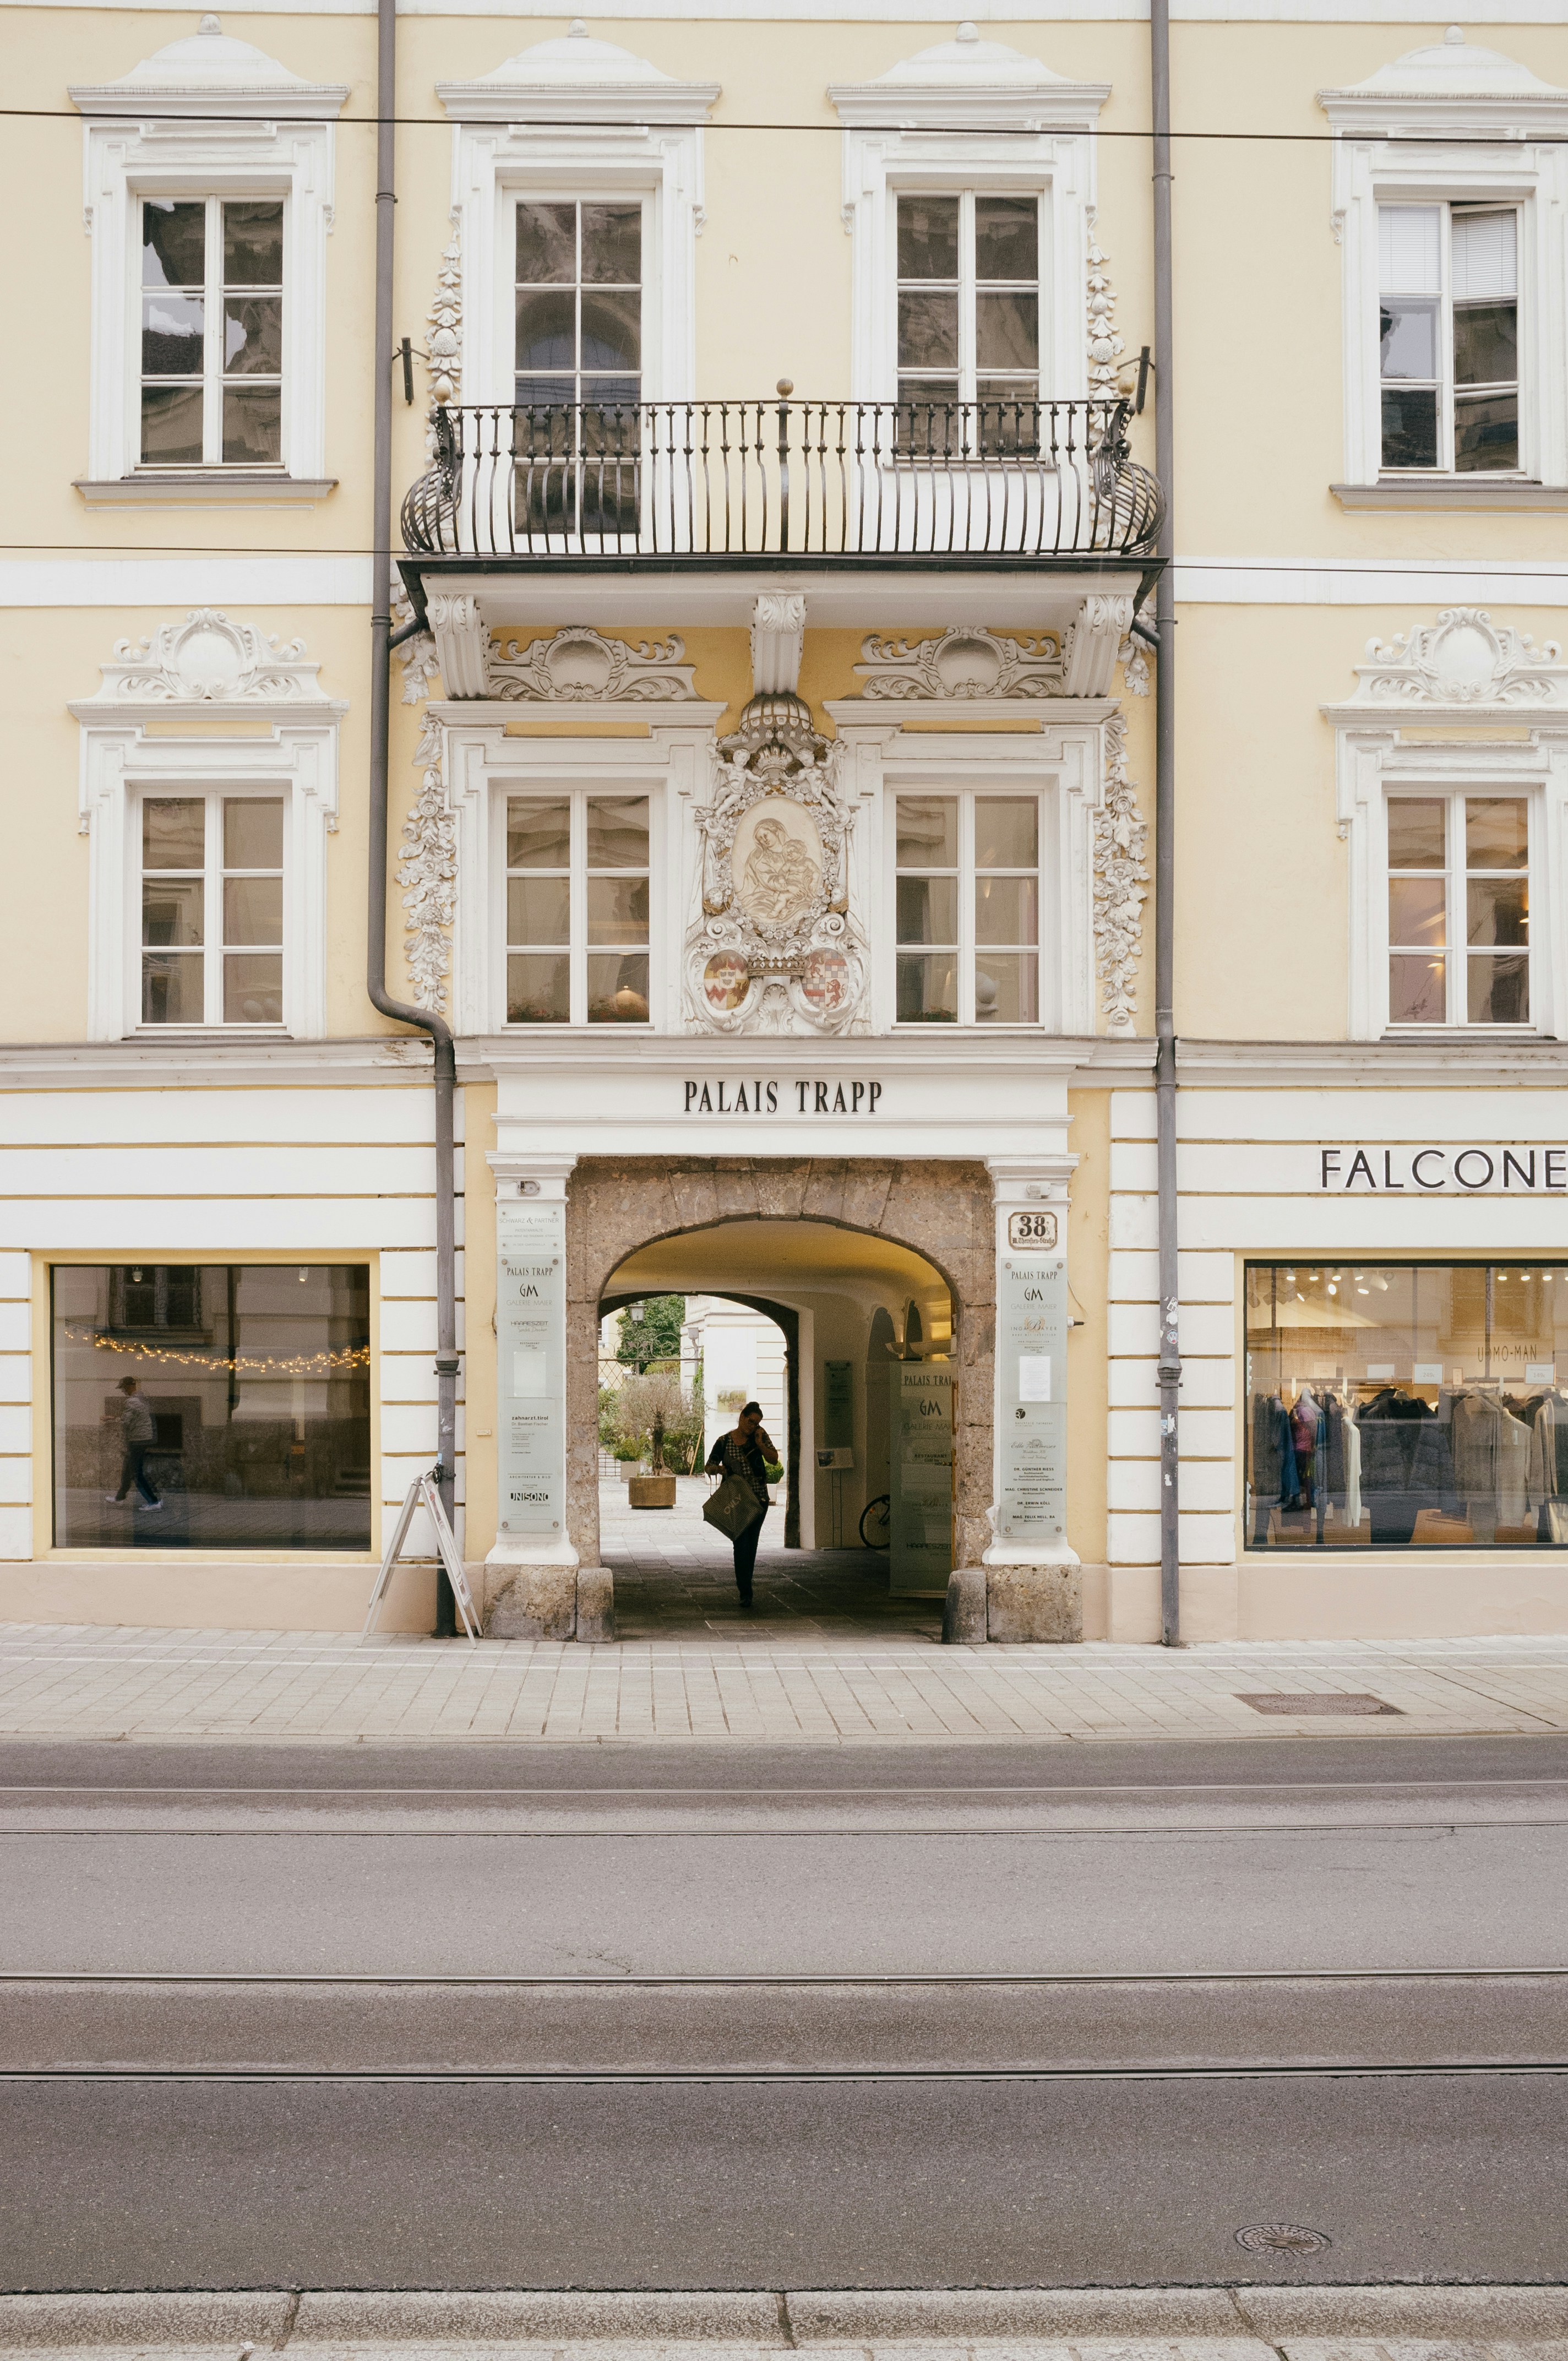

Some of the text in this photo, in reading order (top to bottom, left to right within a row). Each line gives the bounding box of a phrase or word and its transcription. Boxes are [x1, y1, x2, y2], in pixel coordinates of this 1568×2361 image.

[684, 1080, 882, 1113] PALAIS TRAPP
[1321, 1150, 1566, 1189] FALCONE
[1019, 1215, 1046, 1237] 38
[507, 1267, 553, 1276] PALAIS TRAPP
[1011, 1271, 1057, 1280] PALAIS TRAPP
[520, 1283, 538, 1297] GM
[1025, 1287, 1043, 1301] GM
[905, 1375, 930, 1386] PALAIS
[919, 1399, 942, 1416] GM
[510, 1493, 548, 1501] UNISONO
